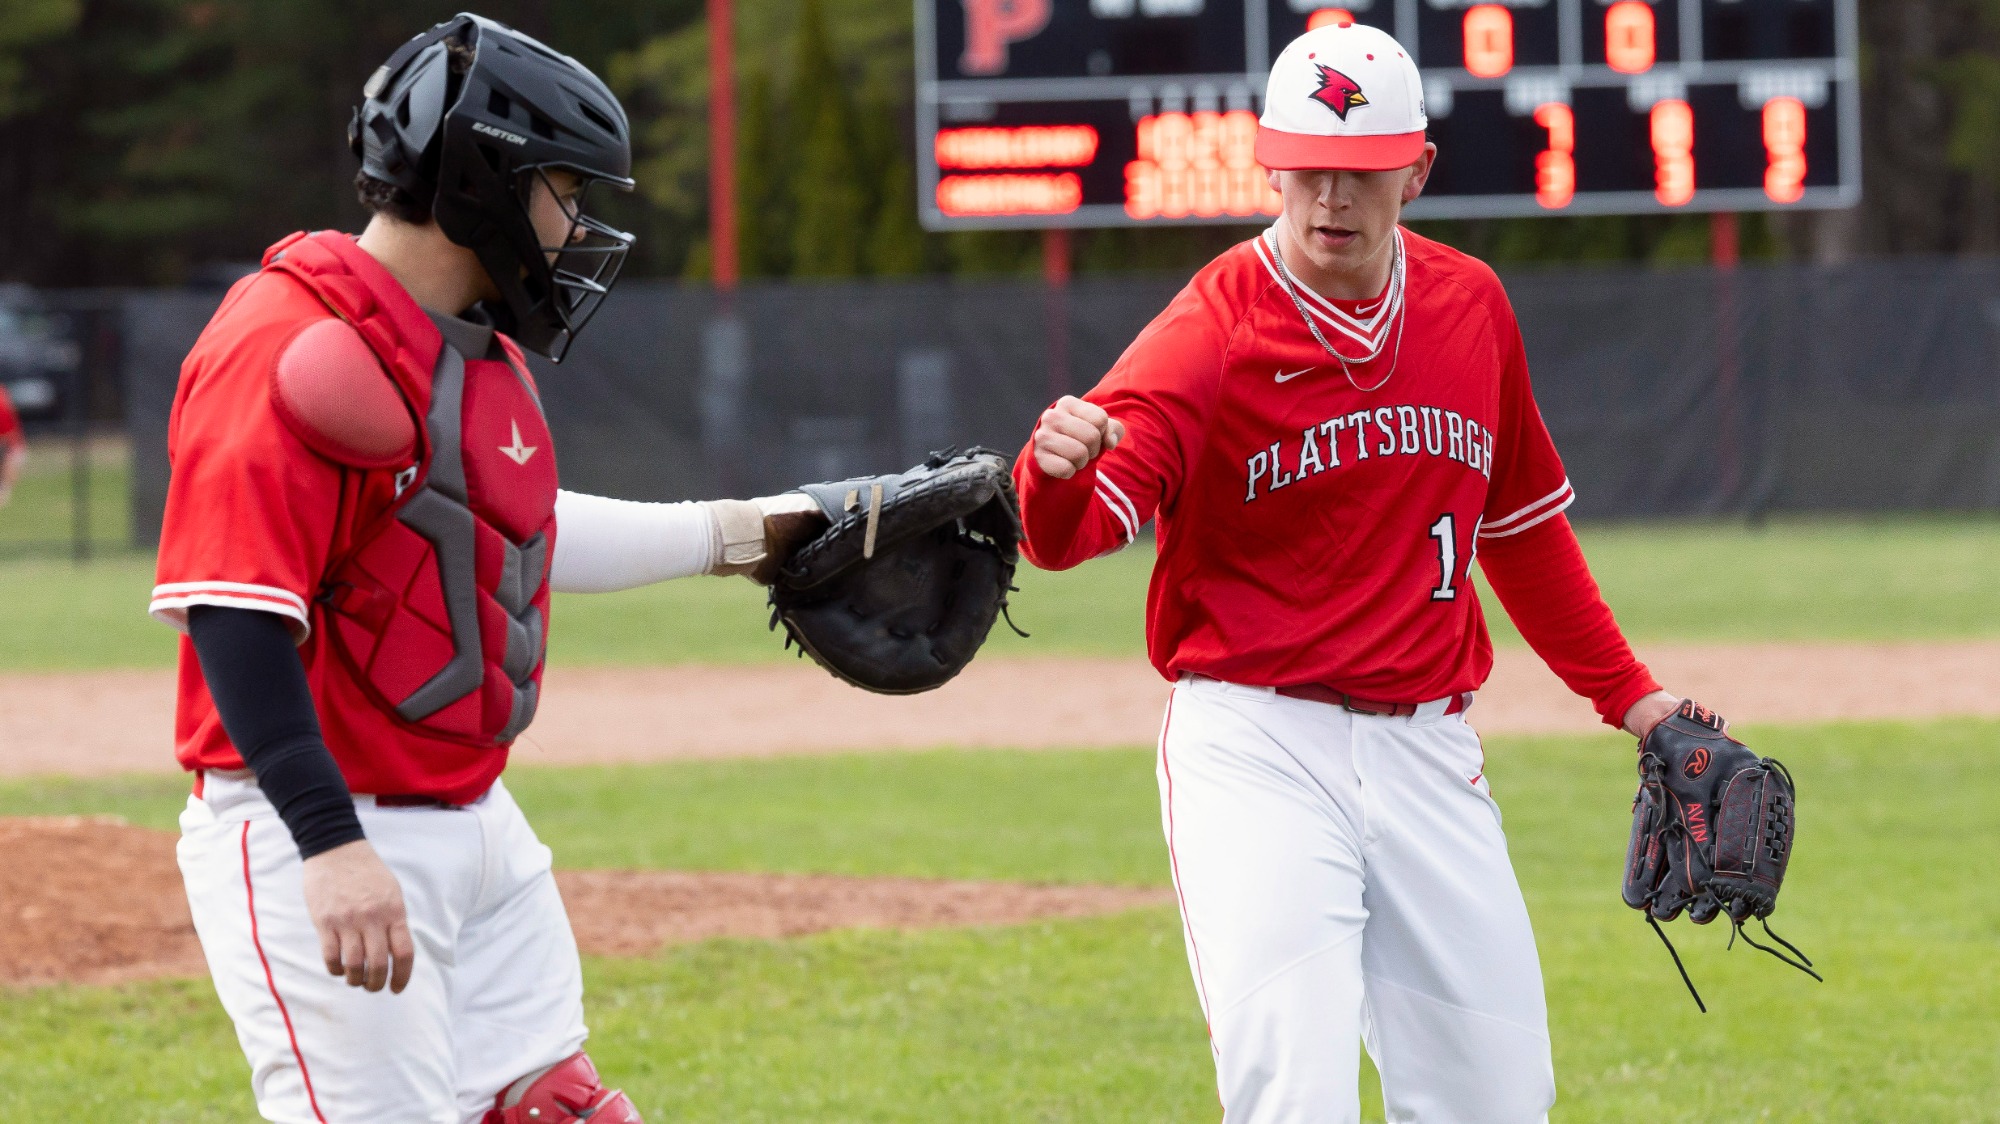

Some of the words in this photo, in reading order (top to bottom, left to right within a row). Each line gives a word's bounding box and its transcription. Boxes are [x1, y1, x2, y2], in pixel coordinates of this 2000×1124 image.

[1463, 4, 1514, 78] 0
[1605, 0, 1656, 74] 0
[471, 121, 528, 146] EASTON
[1244, 404, 1493, 503] PLATTSBURGH
[1428, 512, 1484, 603] 1
[1686, 803, 1708, 843] AVIN
